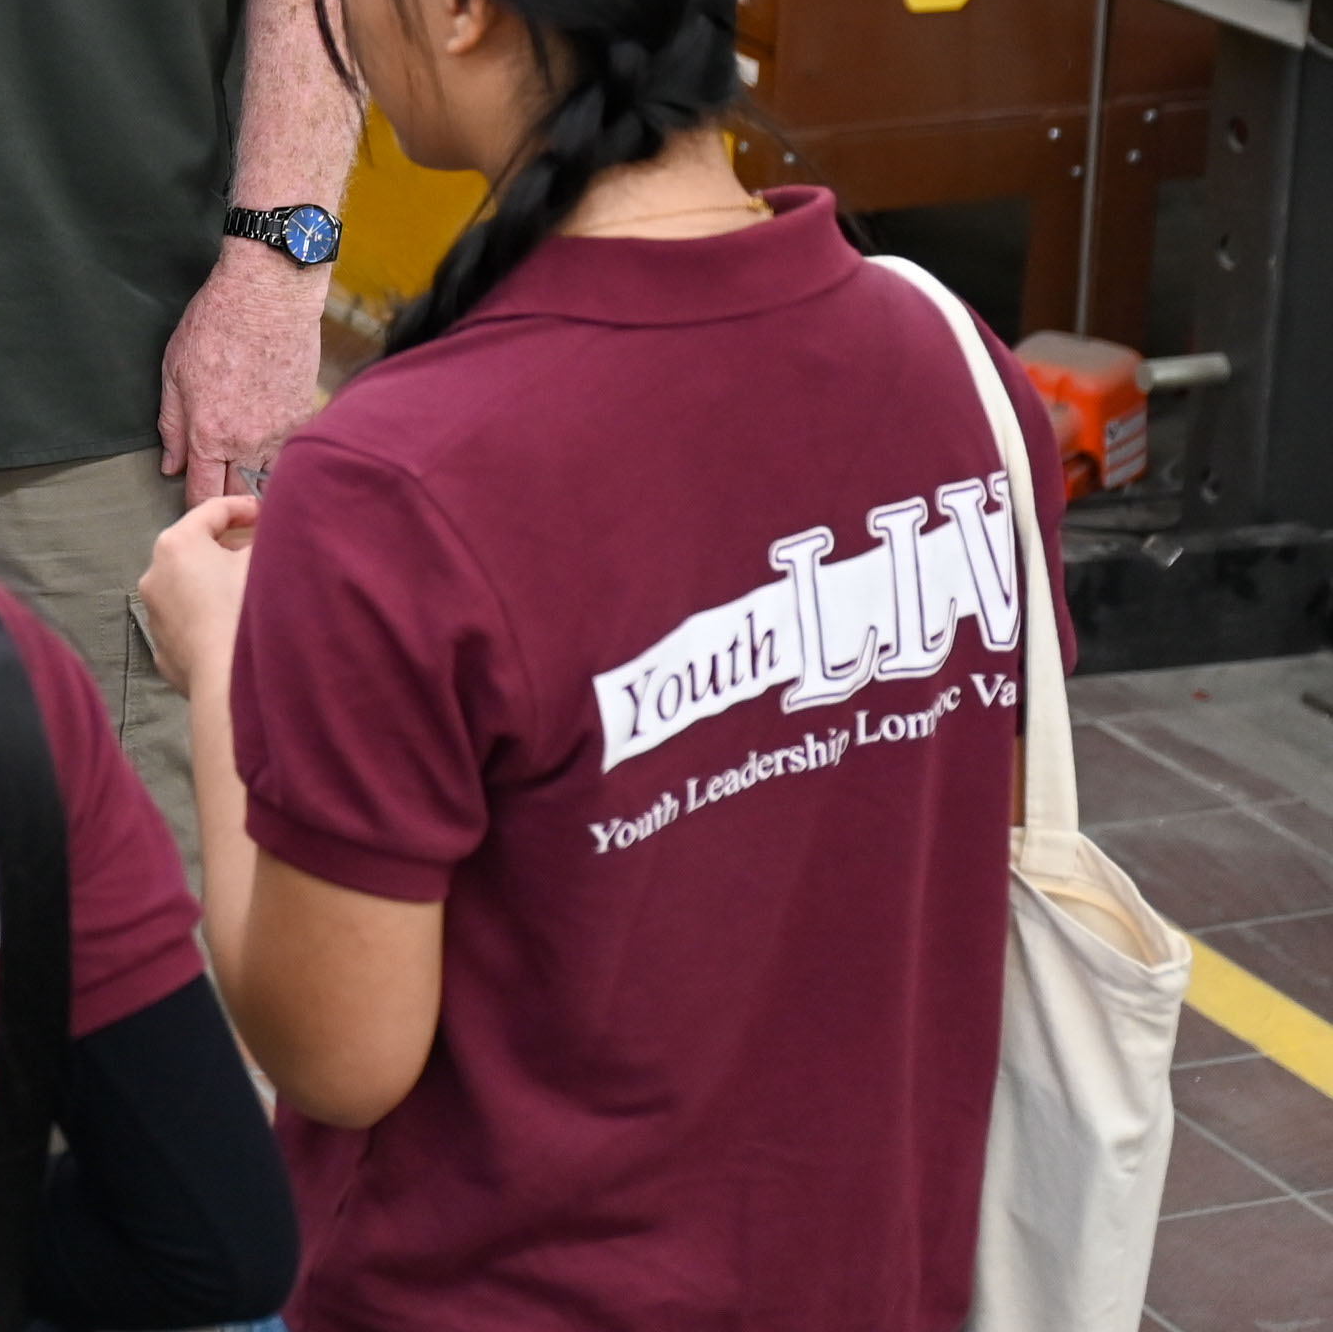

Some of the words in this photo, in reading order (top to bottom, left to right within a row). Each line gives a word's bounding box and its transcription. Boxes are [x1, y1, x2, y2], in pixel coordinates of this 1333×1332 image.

[623, 611, 781, 740] Youth
[768, 470, 1020, 714] LLV
[588, 792, 679, 855] Youth
[685, 727, 851, 815] Leadership
[853, 685, 962, 747] Lomoc
[968, 672, 1019, 709] Va
